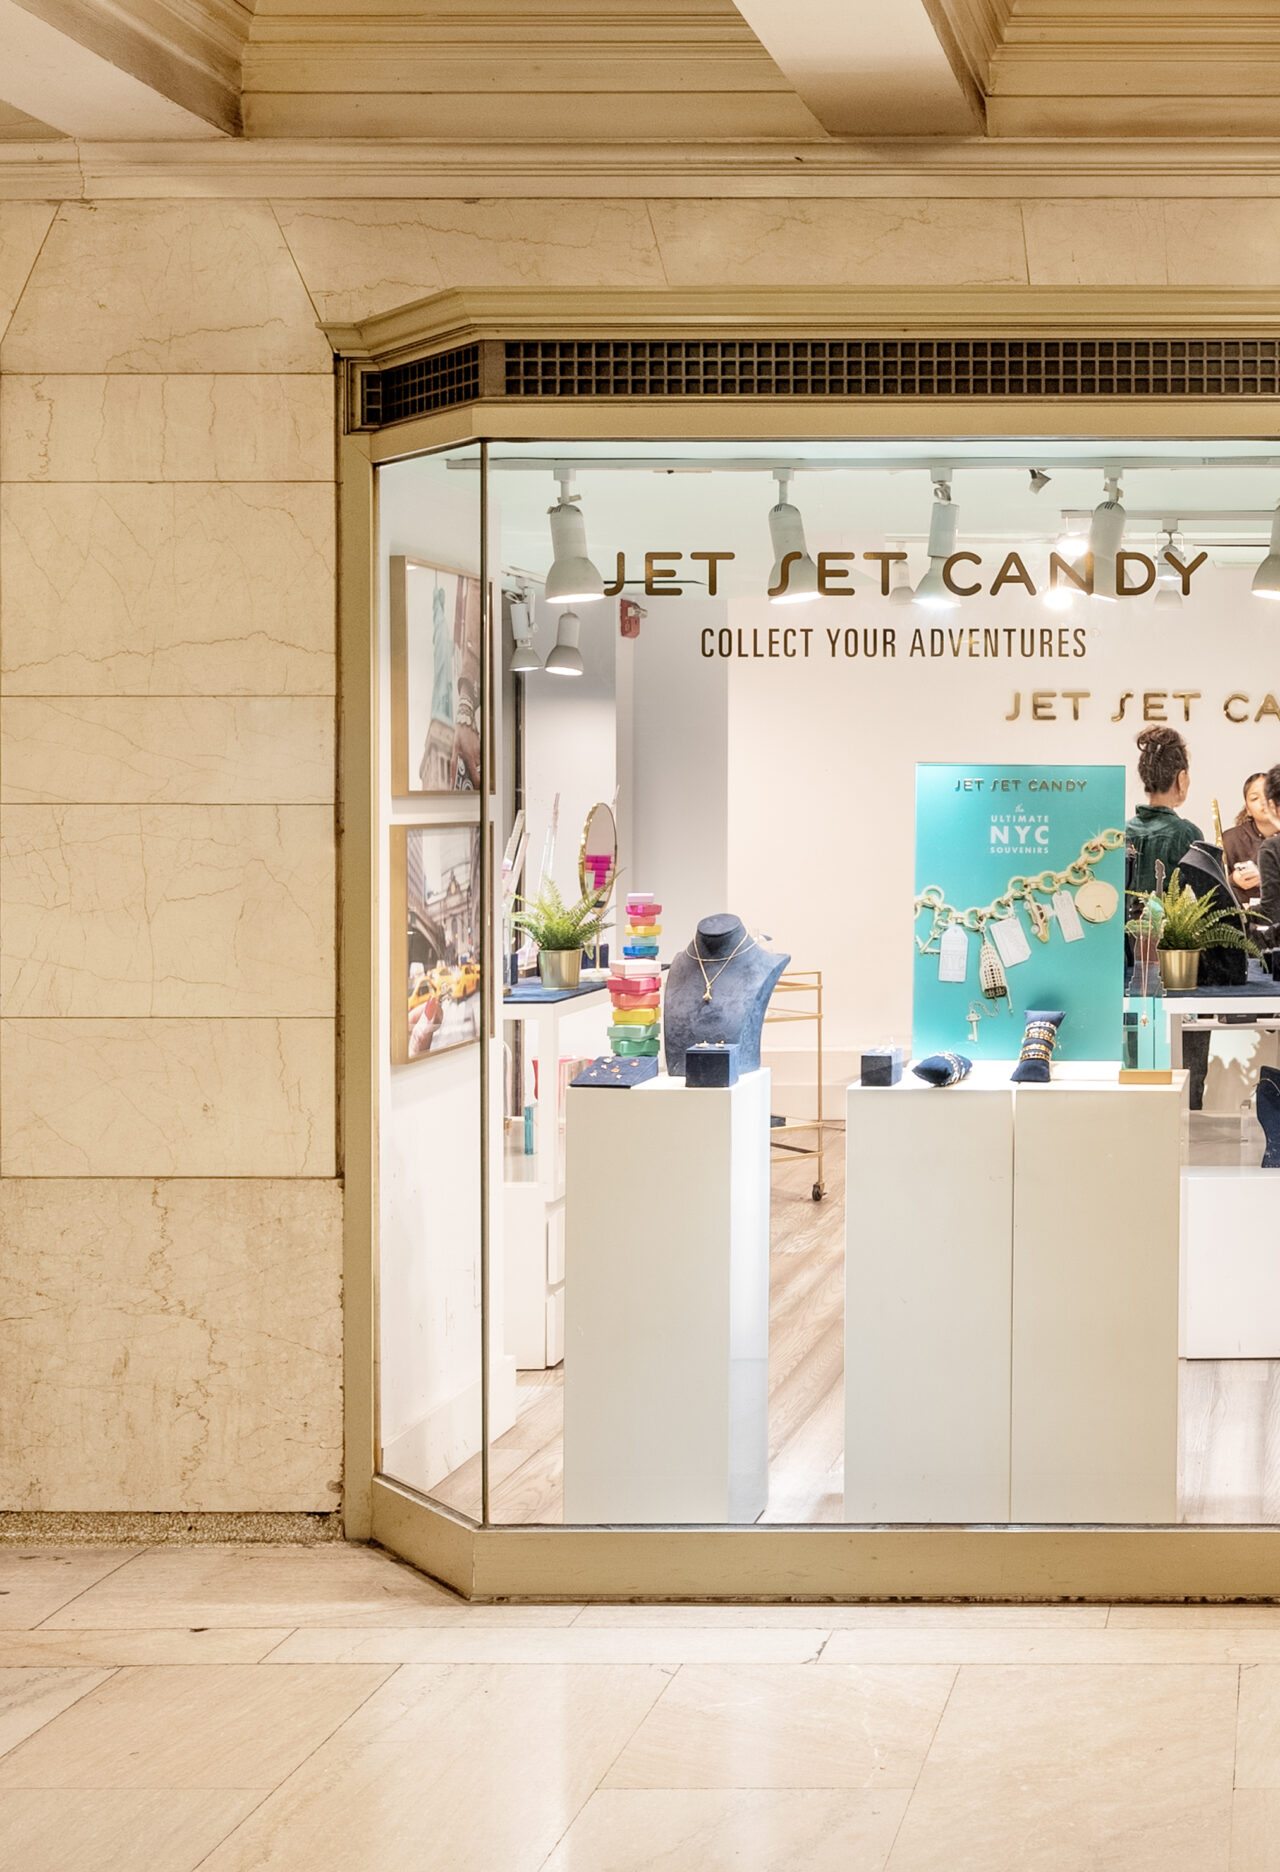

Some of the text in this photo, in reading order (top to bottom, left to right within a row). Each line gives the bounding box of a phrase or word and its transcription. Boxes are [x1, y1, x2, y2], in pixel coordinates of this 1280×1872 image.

[603, 551, 1208, 597] JET SET CANDY
[701, 628, 1087, 658] COLLECT YOUR ADVENTURES
[1005, 691, 1091, 721] JET
[1111, 692, 1201, 722] SET
[955, 778, 1088, 793] JET SET CANDY
[1015, 802, 1025, 813] the
[990, 815, 1049, 823] ULTIMATE
[990, 826, 1049, 844] NYC
[990, 846, 1049, 854] SOUVENIRS
